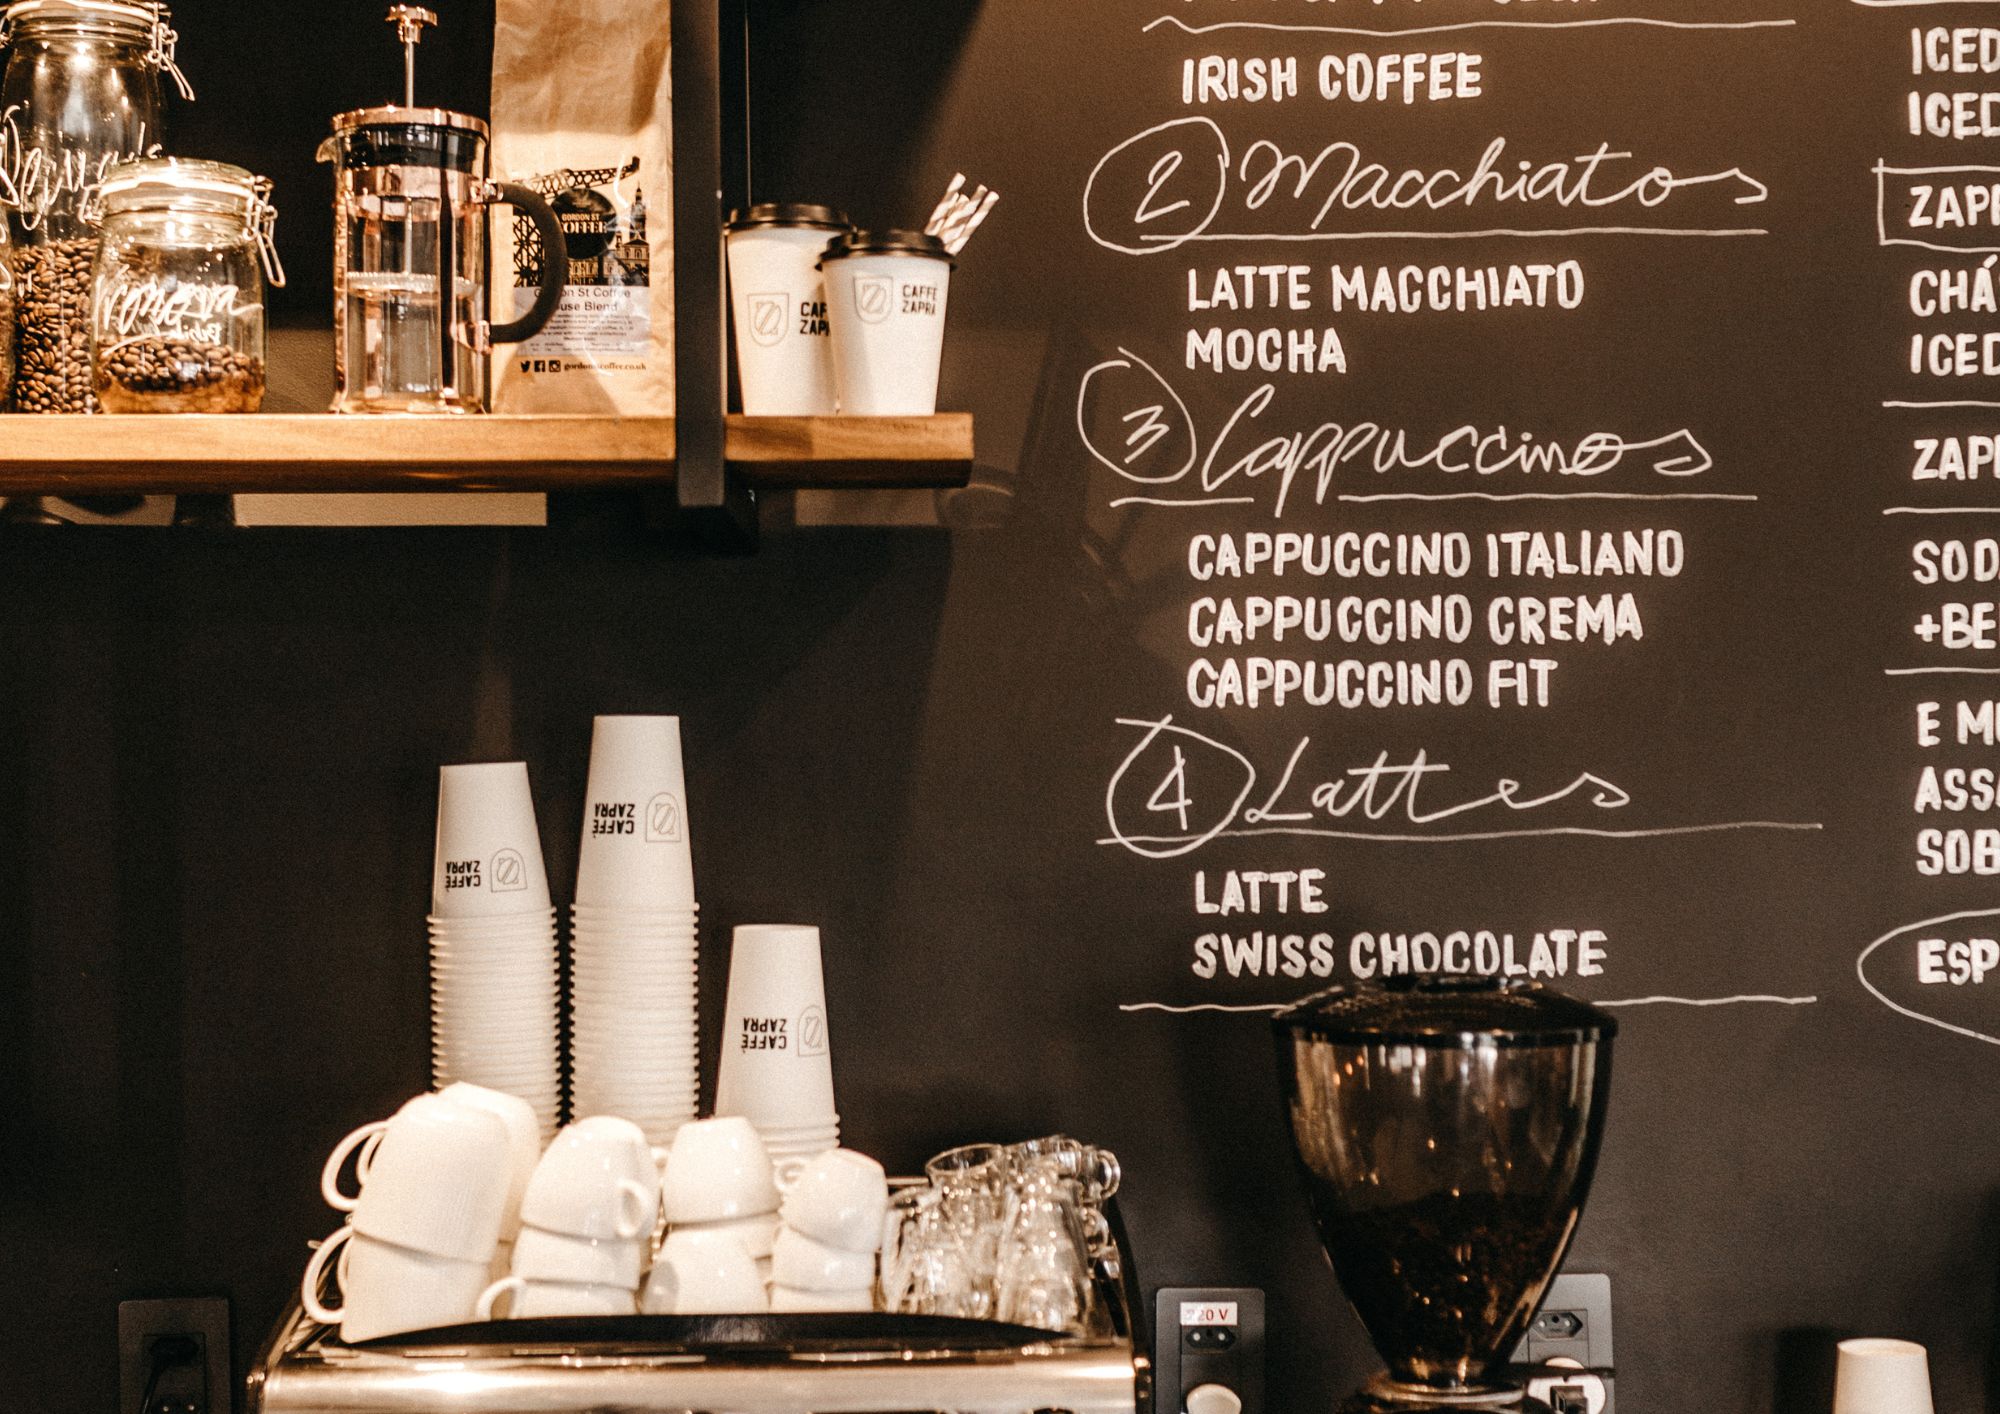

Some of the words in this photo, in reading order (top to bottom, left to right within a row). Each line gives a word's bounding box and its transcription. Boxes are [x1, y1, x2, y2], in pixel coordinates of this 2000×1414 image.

[1911, 26, 2000, 75] ICED
[1182, 55, 1298, 104] IRISH
[1318, 52, 1483, 105] COFFEE
[1908, 91, 2000, 140] ICED
[1134, 150, 1191, 224] 2
[1239, 136, 1768, 230] Macchiatos
[562, 213, 591, 222] GORDON
[591, 213, 600, 222] ST
[562, 222, 607, 234] OFFEE
[578, 287, 590, 298] St
[584, 301, 618, 312] Blend
[902, 301, 936, 316] ZAPRA
[1188, 264, 1311, 312] LATTE
[1331, 260, 1585, 313] MACCHIATO
[1186, 327, 1347, 374] MOCHA
[1910, 332, 2000, 376] ICED
[1122, 405, 1170, 464] 3
[1201, 383, 1713, 517] Cappuccinos
[1912, 434, 2000, 481] ZAP
[1188, 532, 1471, 581] CAPPUCCINO
[1486, 528, 1684, 579] ITALIANO
[1188, 594, 1472, 647] CAPPUCCINO
[1488, 592, 1643, 646] CREMA
[1187, 656, 1473, 709] CAPPUCCINO
[1488, 658, 1559, 708] FIT
[1916, 701, 1941, 747] E
[1956, 700, 2000, 746] M
[1145, 745, 1193, 831] 4
[1245, 736, 1630, 824] Lattes
[1914, 766, 2000, 814] ASS
[595, 803, 635, 818] ZAPRA
[445, 860, 481, 873] ZAPRA
[1916, 828, 2000, 876] SOB
[1195, 868, 1329, 916] LATTE
[1192, 931, 1334, 979] SWISS
[1350, 929, 1608, 979] CHOCOLATE
[1917, 938, 2000, 985] ESP
[743, 1017, 787, 1032] ZAPRA
[1219, 1309, 1228, 1321] V
